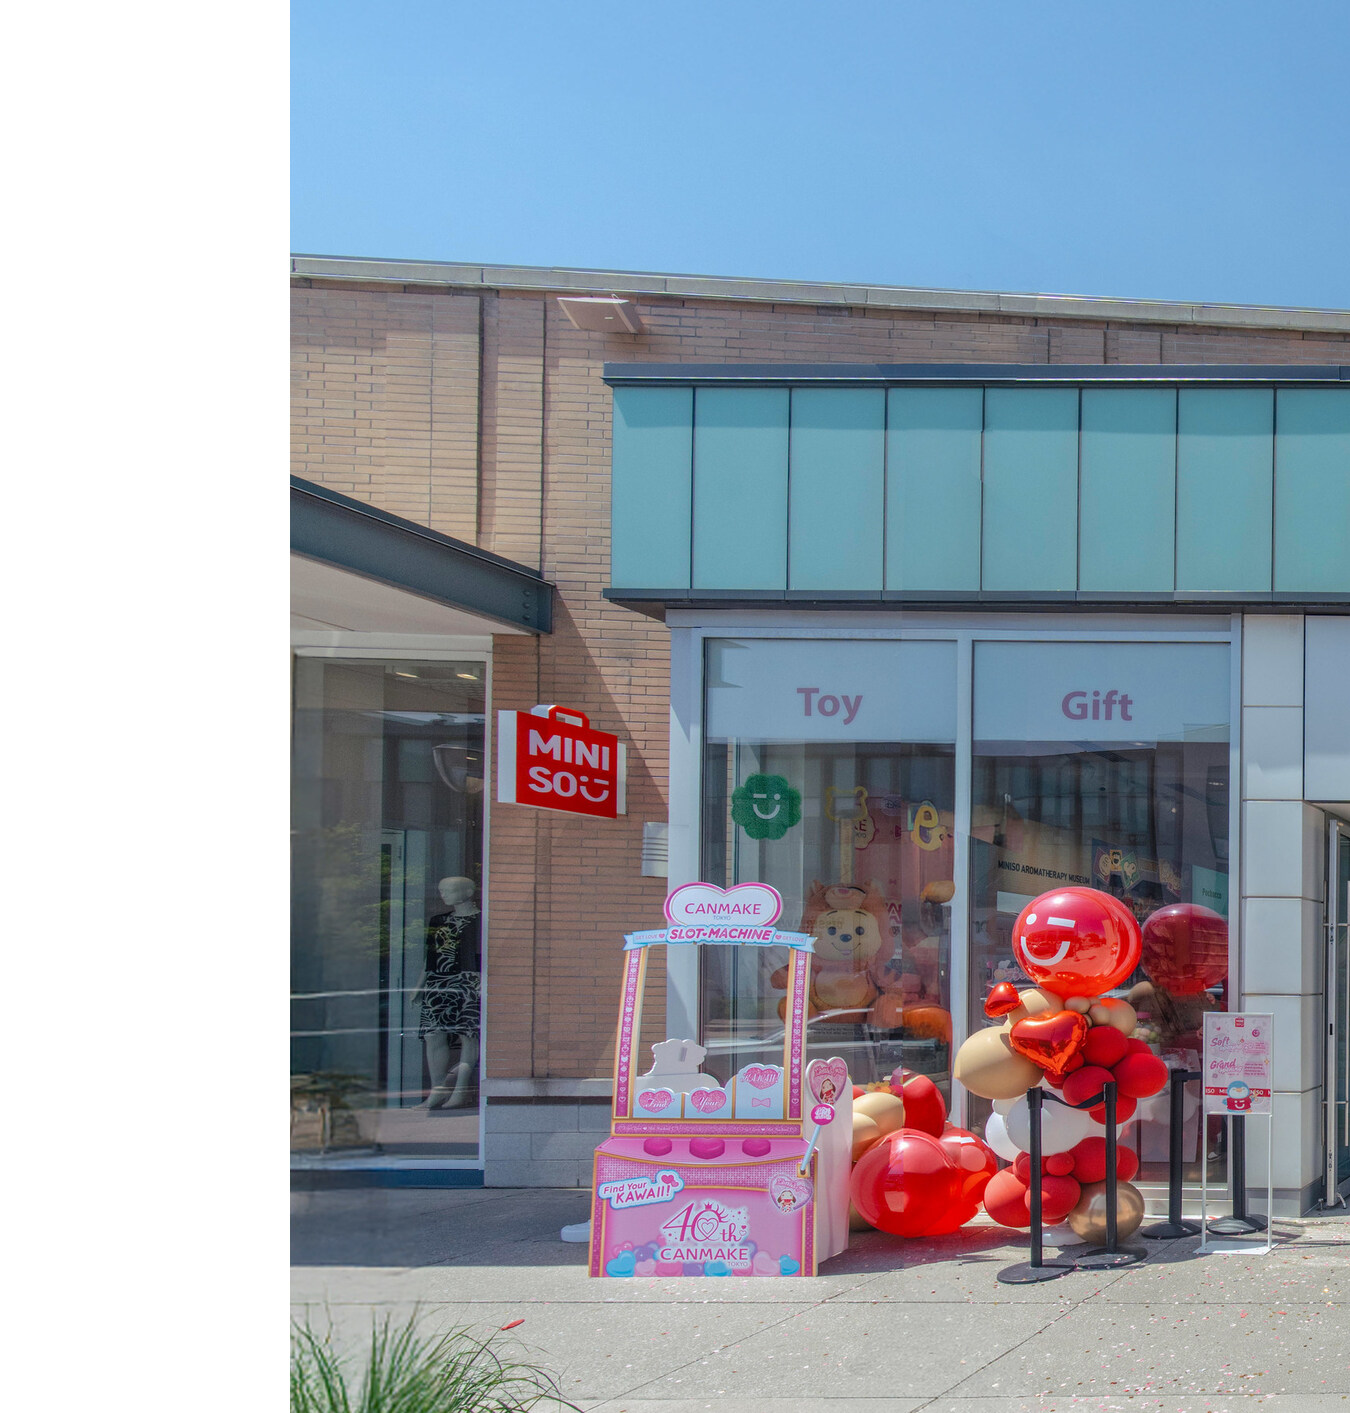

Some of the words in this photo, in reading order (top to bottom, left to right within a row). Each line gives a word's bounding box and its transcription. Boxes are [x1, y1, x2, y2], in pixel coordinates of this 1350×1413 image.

[796, 687, 864, 726] Toy
[1061, 690, 1134, 722] Gift
[528, 728, 610, 772] MINI
[998, 859, 1020, 872] MINISO
[1021, 864, 1068, 881] AROMATHERAPY
[1068, 873, 1090, 885] MUSEUM
[684, 902, 762, 915] CANMAKE
[669, 927, 704, 940] SLOT
[707, 927, 773, 941] MACHINE
[1210, 1036, 1230, 1048] Soft
[1210, 1058, 1237, 1070] Grand
[603, 1183, 625, 1195] Find
[627, 1181, 648, 1192] Your
[615, 1184, 671, 1204] KAWAII!
[660, 1248, 749, 1261] CANMAKE
